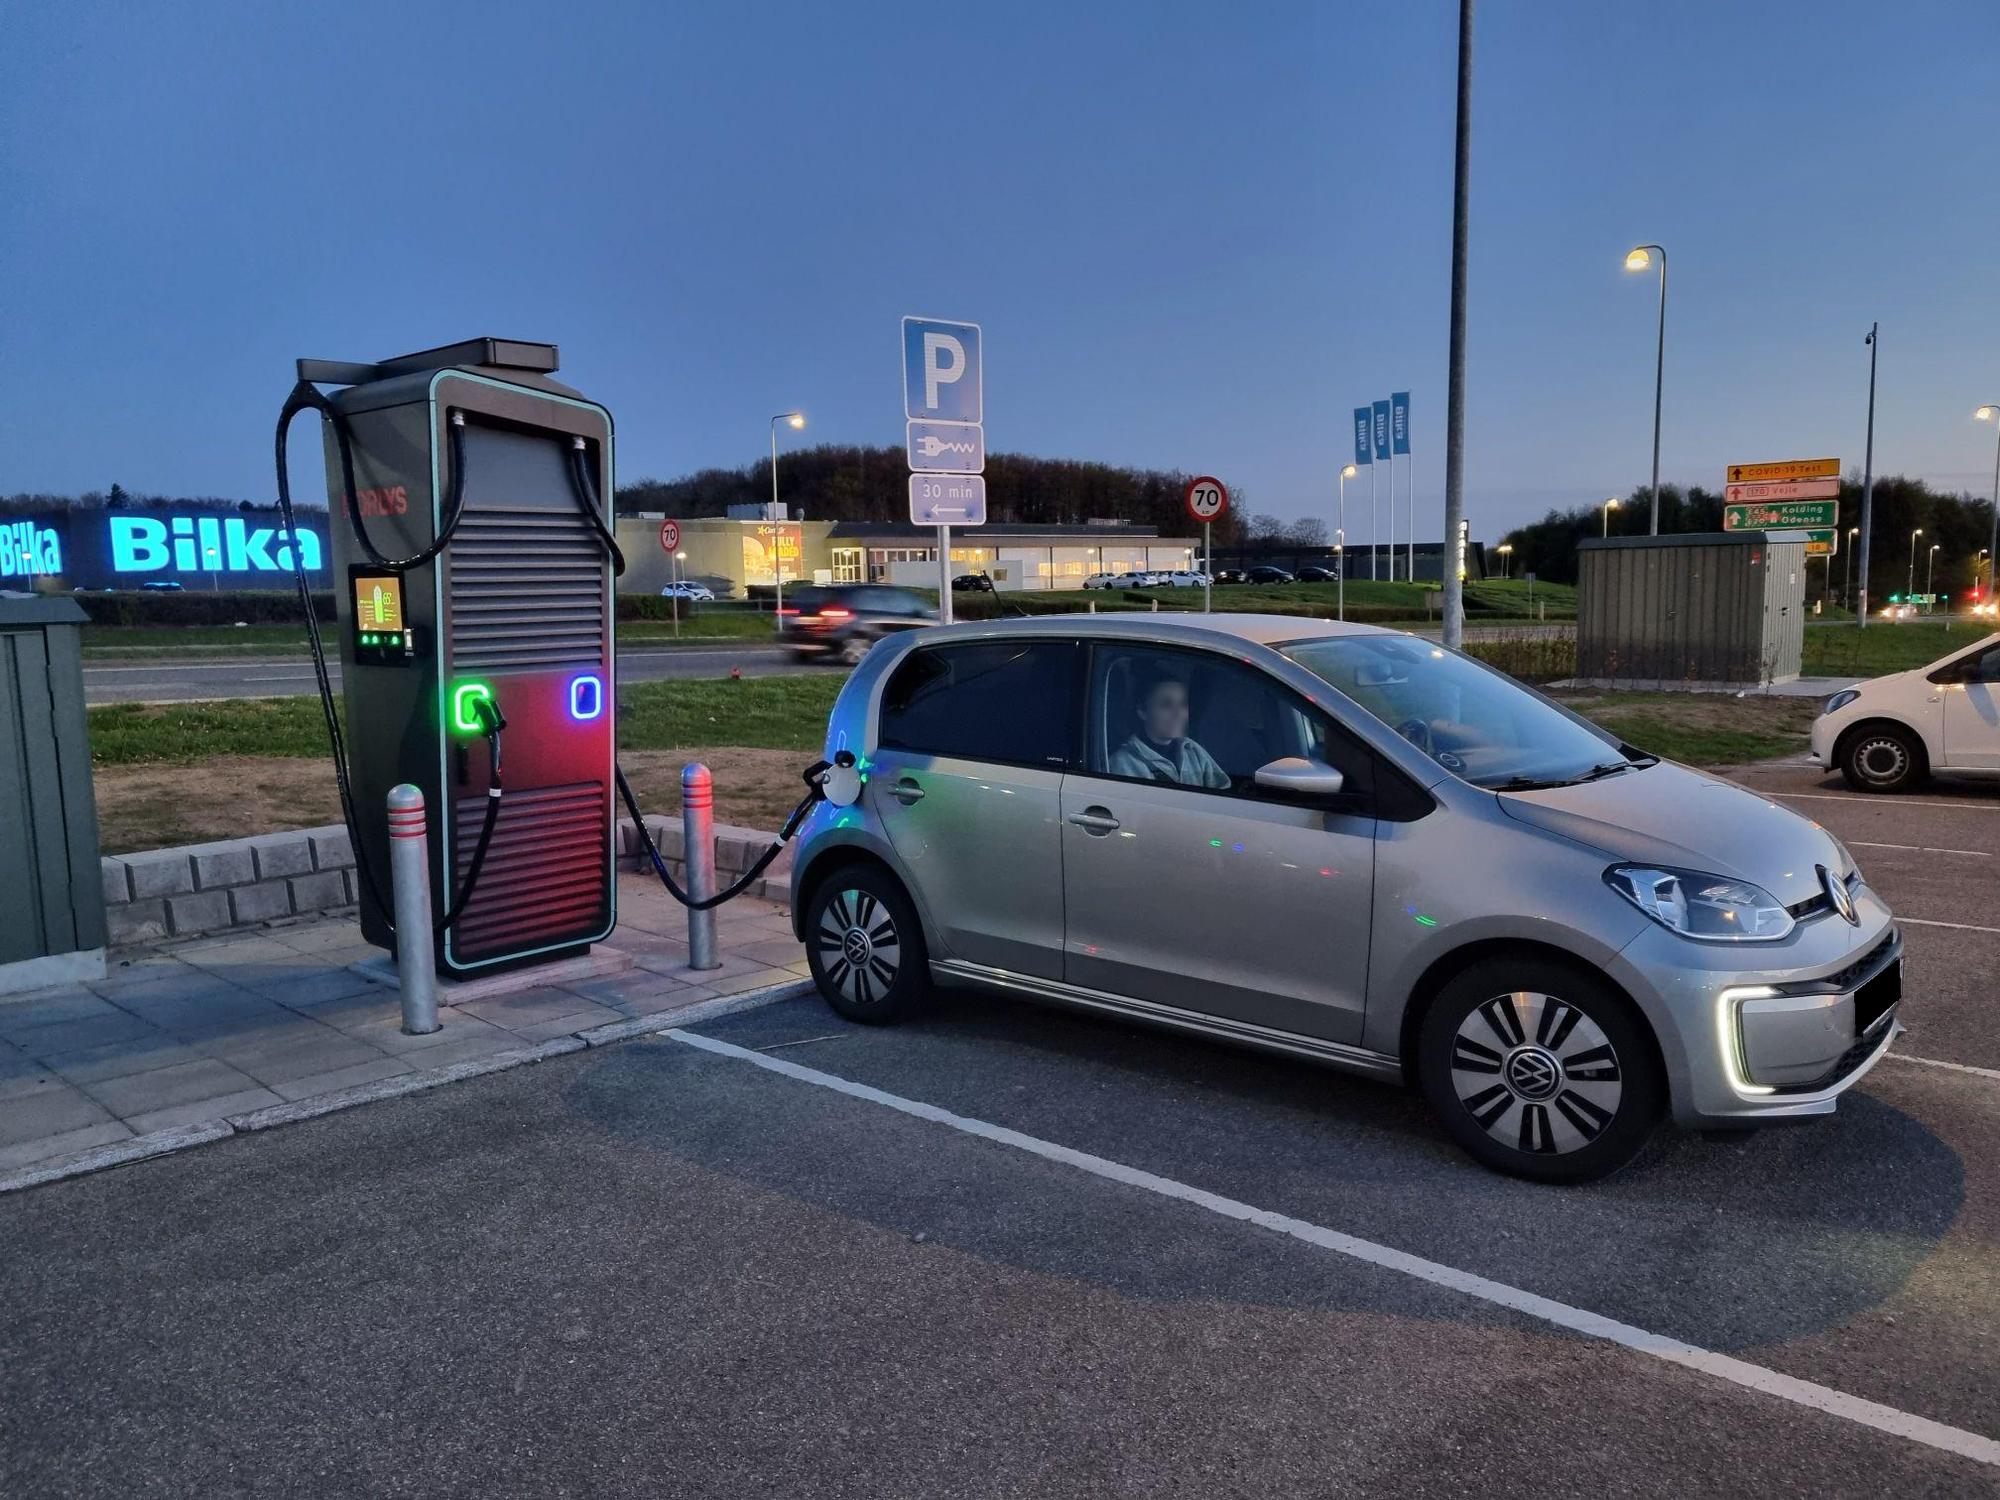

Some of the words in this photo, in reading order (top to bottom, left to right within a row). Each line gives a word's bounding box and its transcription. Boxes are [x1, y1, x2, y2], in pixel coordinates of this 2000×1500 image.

[923, 332, 966, 409] P
[922, 484, 942, 498] 30
[949, 484, 973, 498] min
[1195, 489, 1219, 506] 70
[1773, 487, 1798, 495] Vejle
[1781, 506, 1824, 514] Kolding
[1781, 516, 1823, 524] Odense
[665, 528, 677, 541] 70
[0, 521, 63, 577] Bilka
[110, 516, 322, 572] Bilka
